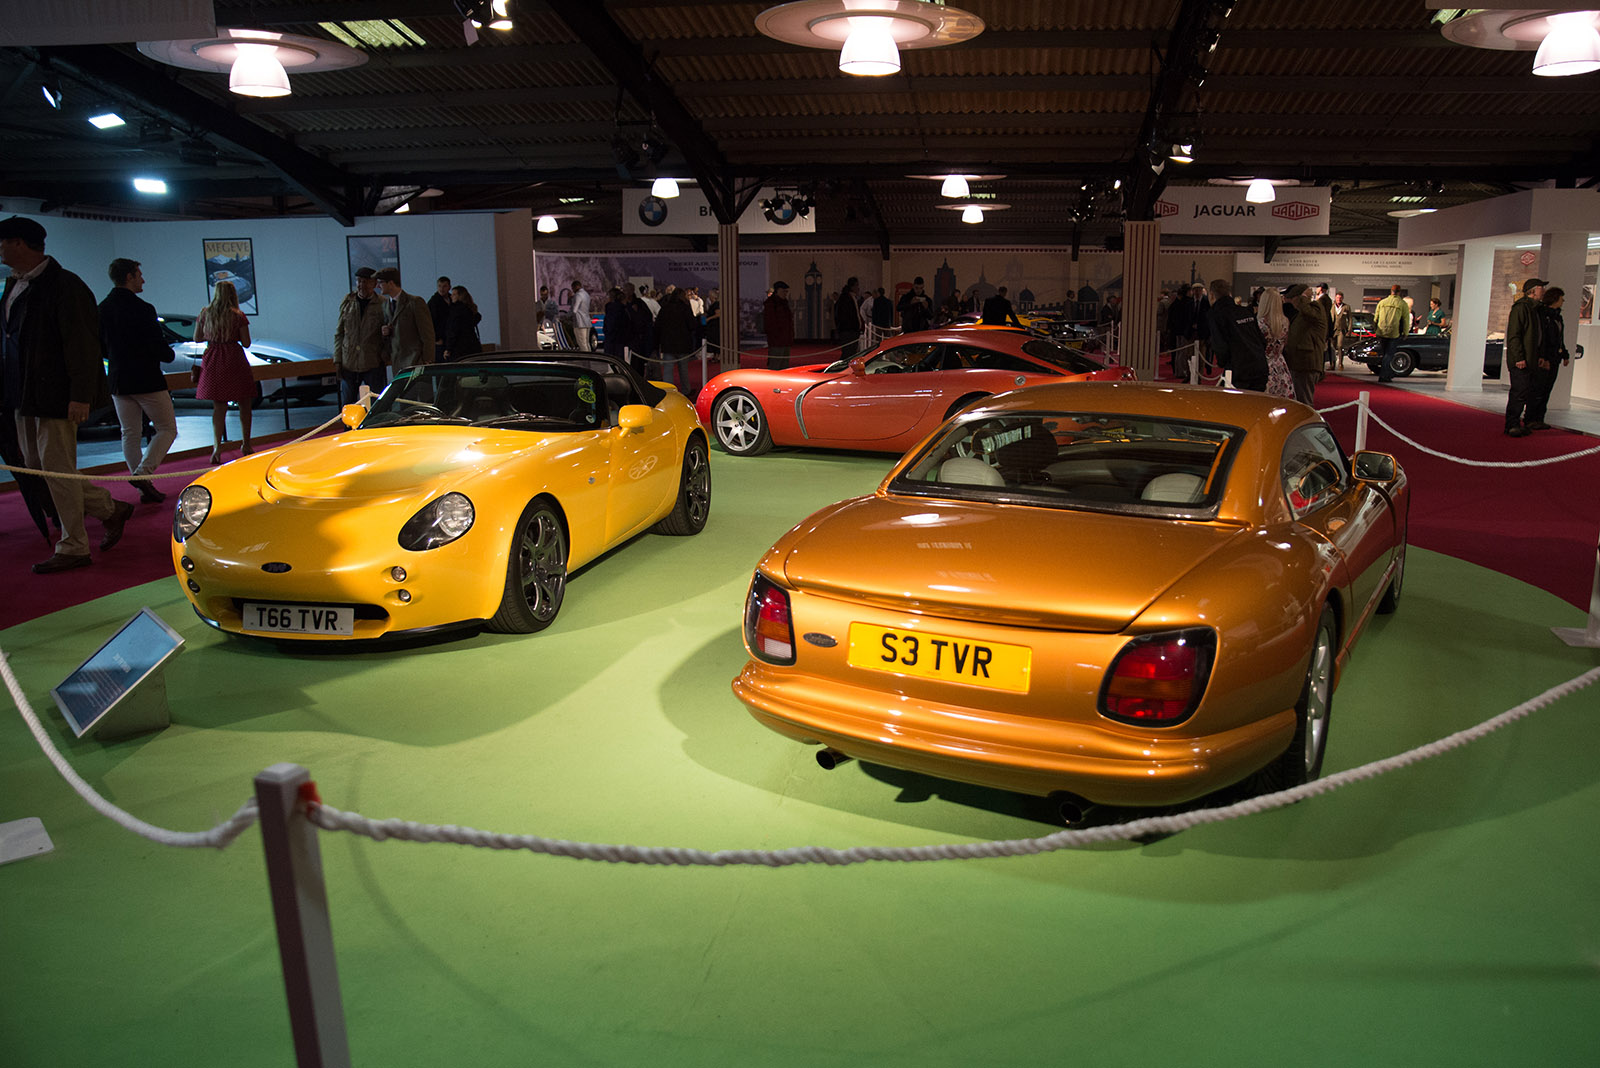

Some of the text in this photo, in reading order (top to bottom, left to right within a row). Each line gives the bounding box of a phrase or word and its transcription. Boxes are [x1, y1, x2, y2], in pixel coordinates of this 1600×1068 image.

[1193, 204, 1256, 219] JAGUAR
[1274, 203, 1317, 218] JAGUAR
[256, 607, 338, 631] T66 TVR
[881, 632, 992, 679] S3 TVR
